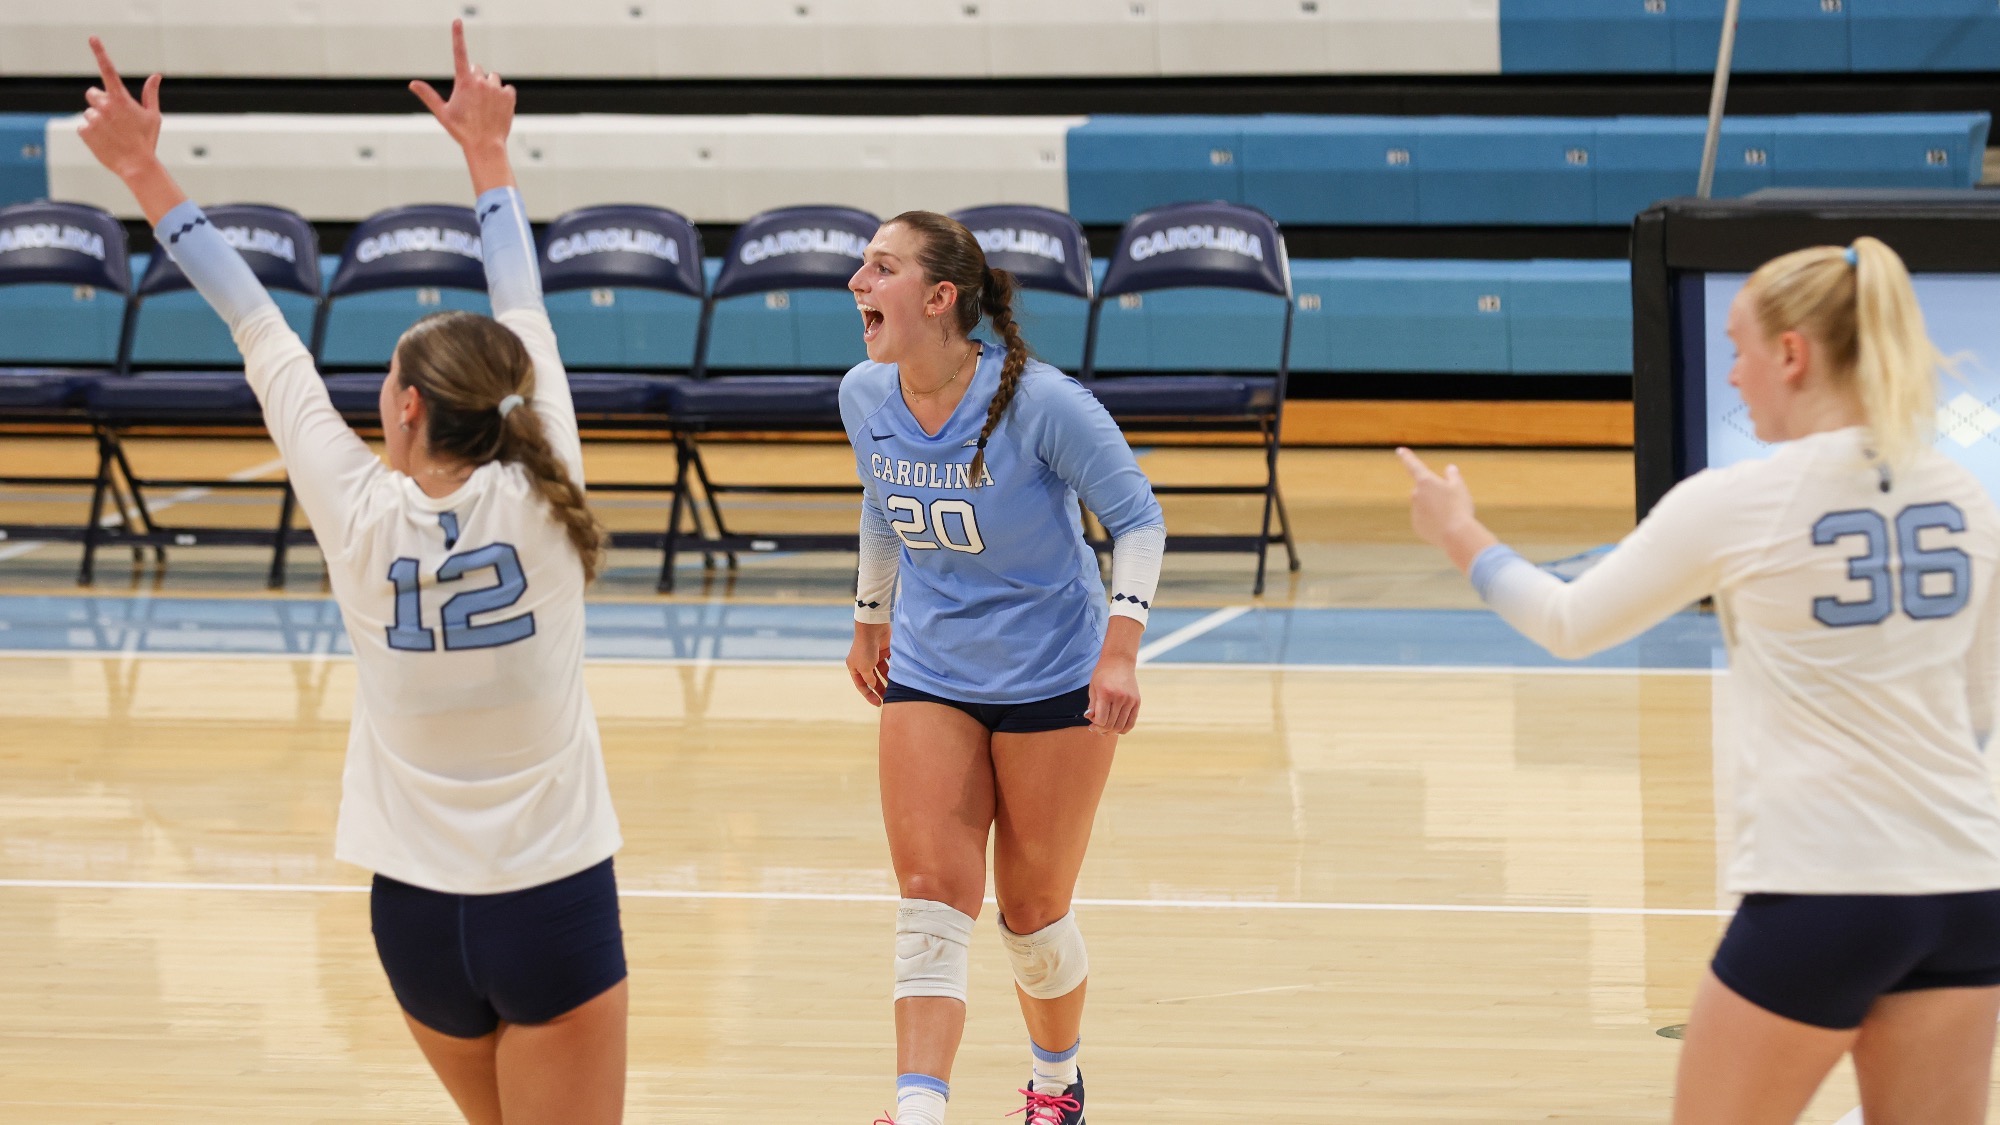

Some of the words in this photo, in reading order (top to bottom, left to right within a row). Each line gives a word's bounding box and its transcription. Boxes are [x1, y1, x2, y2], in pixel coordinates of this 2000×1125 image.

[0, 223, 105, 261] AROLINA
[547, 227, 680, 265] CAROLINA
[1129, 224, 1264, 262] CAROLINA
[870, 452, 995, 489] CAROLINA
[887, 493, 986, 555] 20
[1812, 501, 1971, 628] 36
[385, 541, 536, 652] 12
